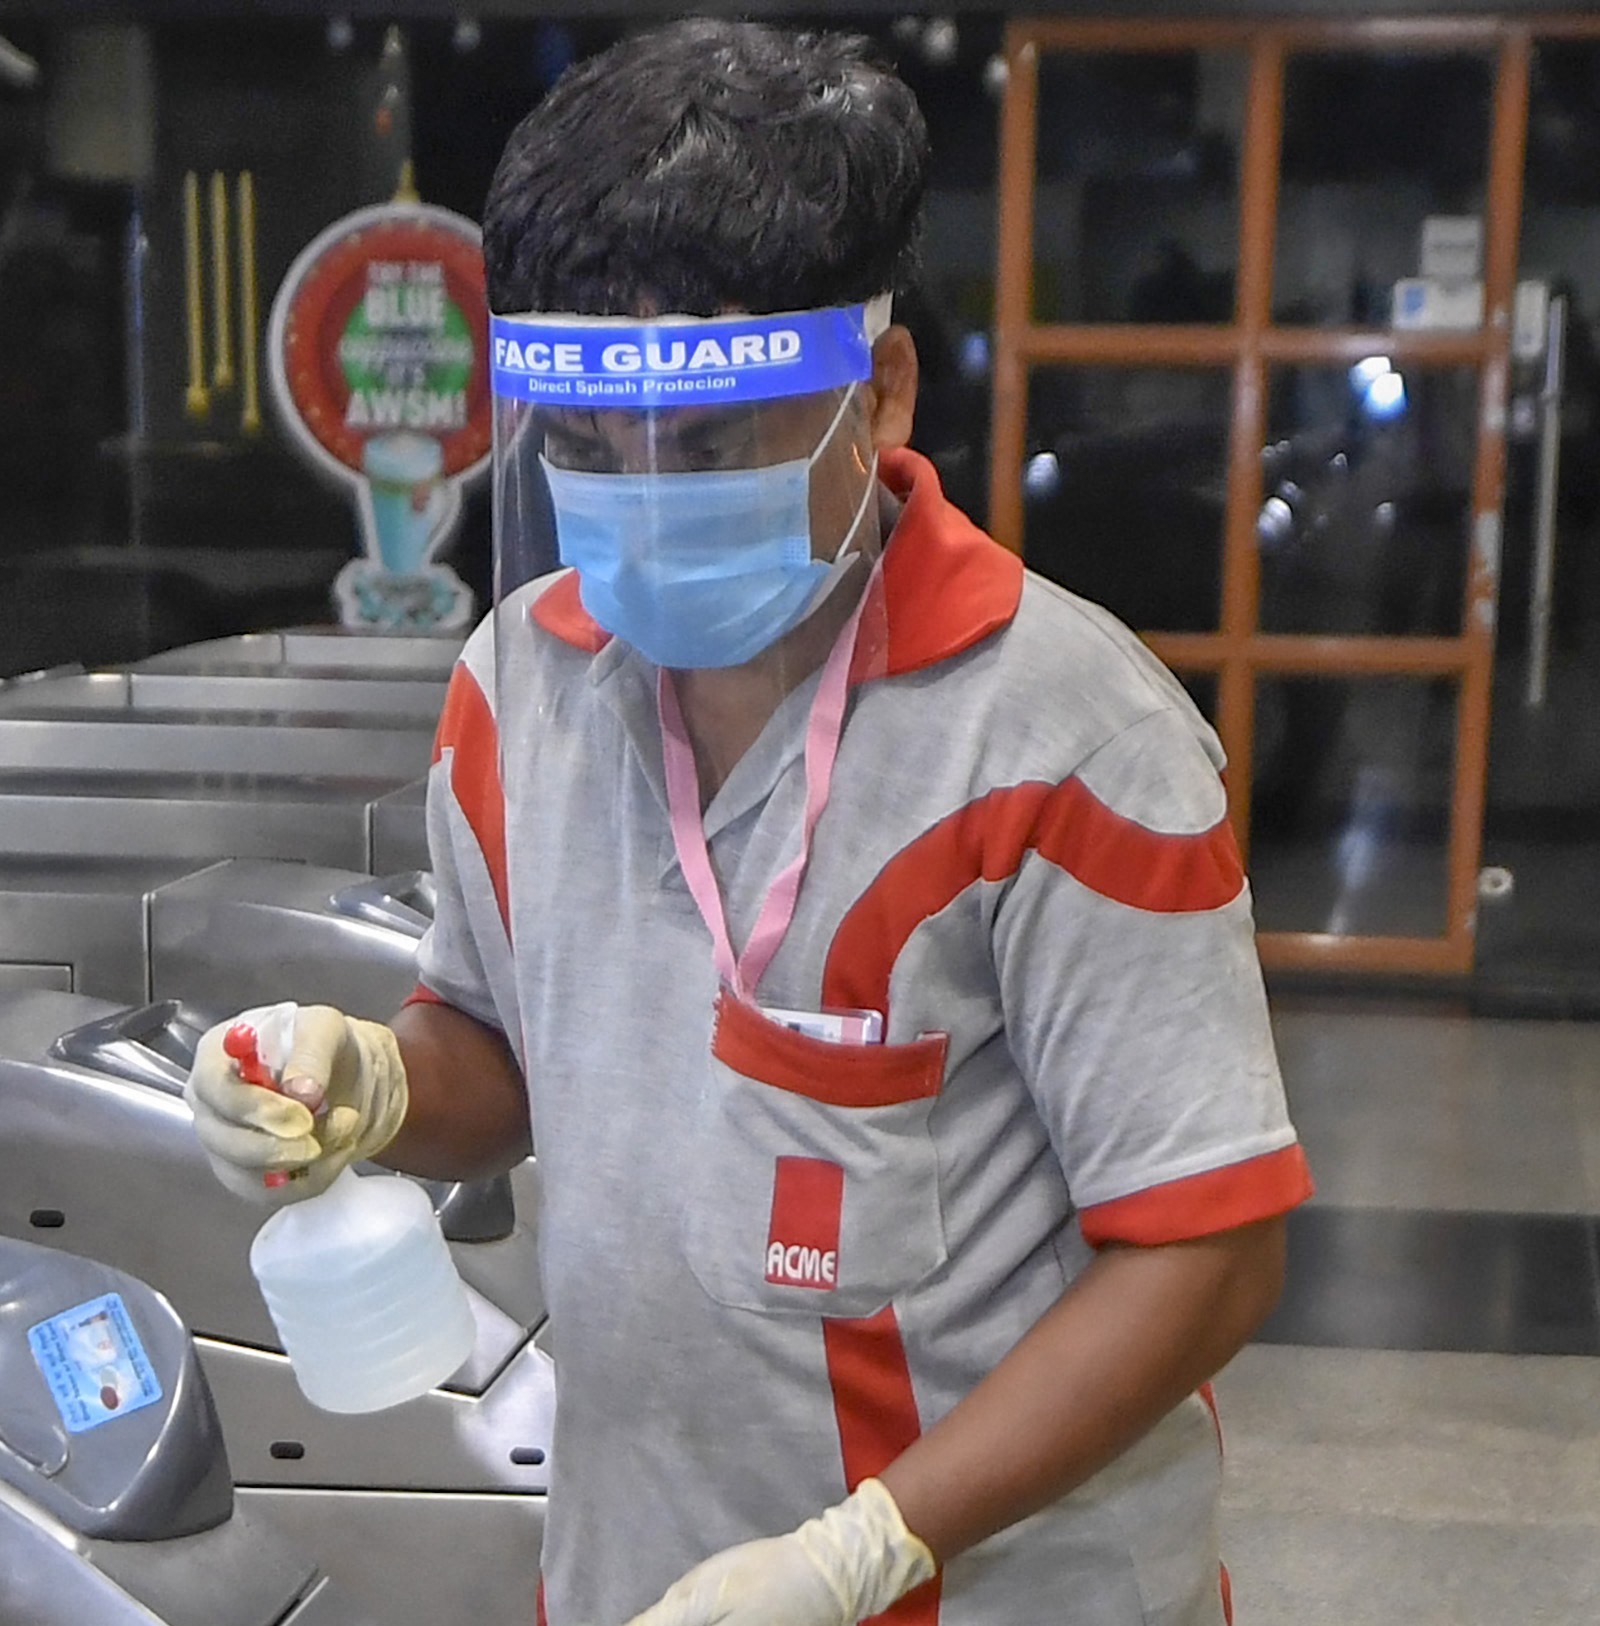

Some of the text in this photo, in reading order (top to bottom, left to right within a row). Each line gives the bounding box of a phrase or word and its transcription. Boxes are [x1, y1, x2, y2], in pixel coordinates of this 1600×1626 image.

[364, 286, 446, 328] BLUE
[495, 337, 584, 372] FACE
[602, 330, 801, 372] GUARD
[529, 376, 737, 396] Direct Splash Protecion
[767, 1242, 836, 1282] ACME
